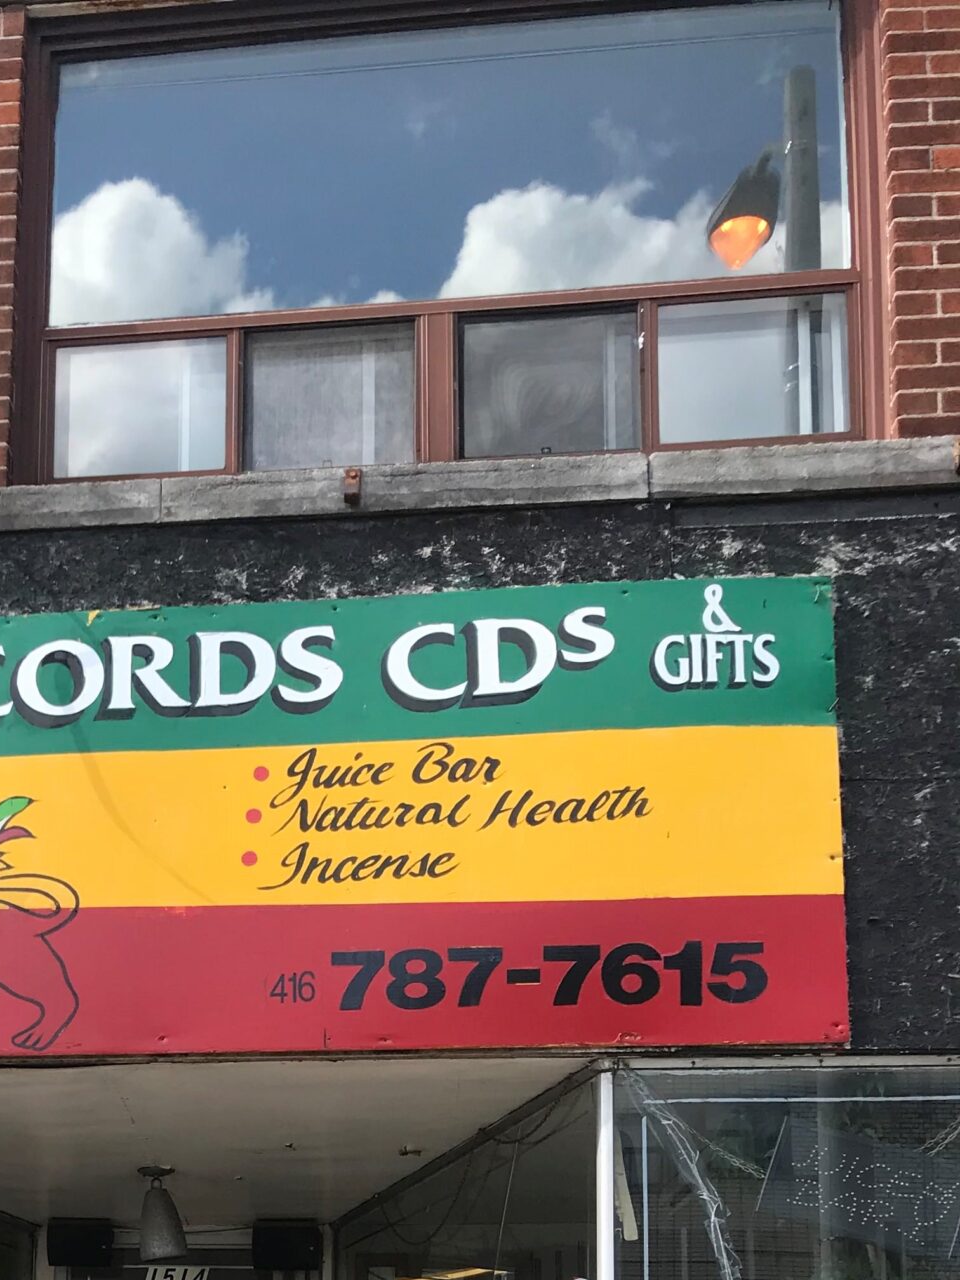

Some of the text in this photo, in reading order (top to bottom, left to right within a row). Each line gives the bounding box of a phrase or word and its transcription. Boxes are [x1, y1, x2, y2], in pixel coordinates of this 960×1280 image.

[701, 583, 740, 634] &
[649, 631, 781, 693] GIFTS
[269, 742, 505, 808] Juice Bar
[269, 784, 655, 835] Natural Health
[256, 841, 460, 891] Incense
[269, 940, 770, 1012] 416 787-7615
